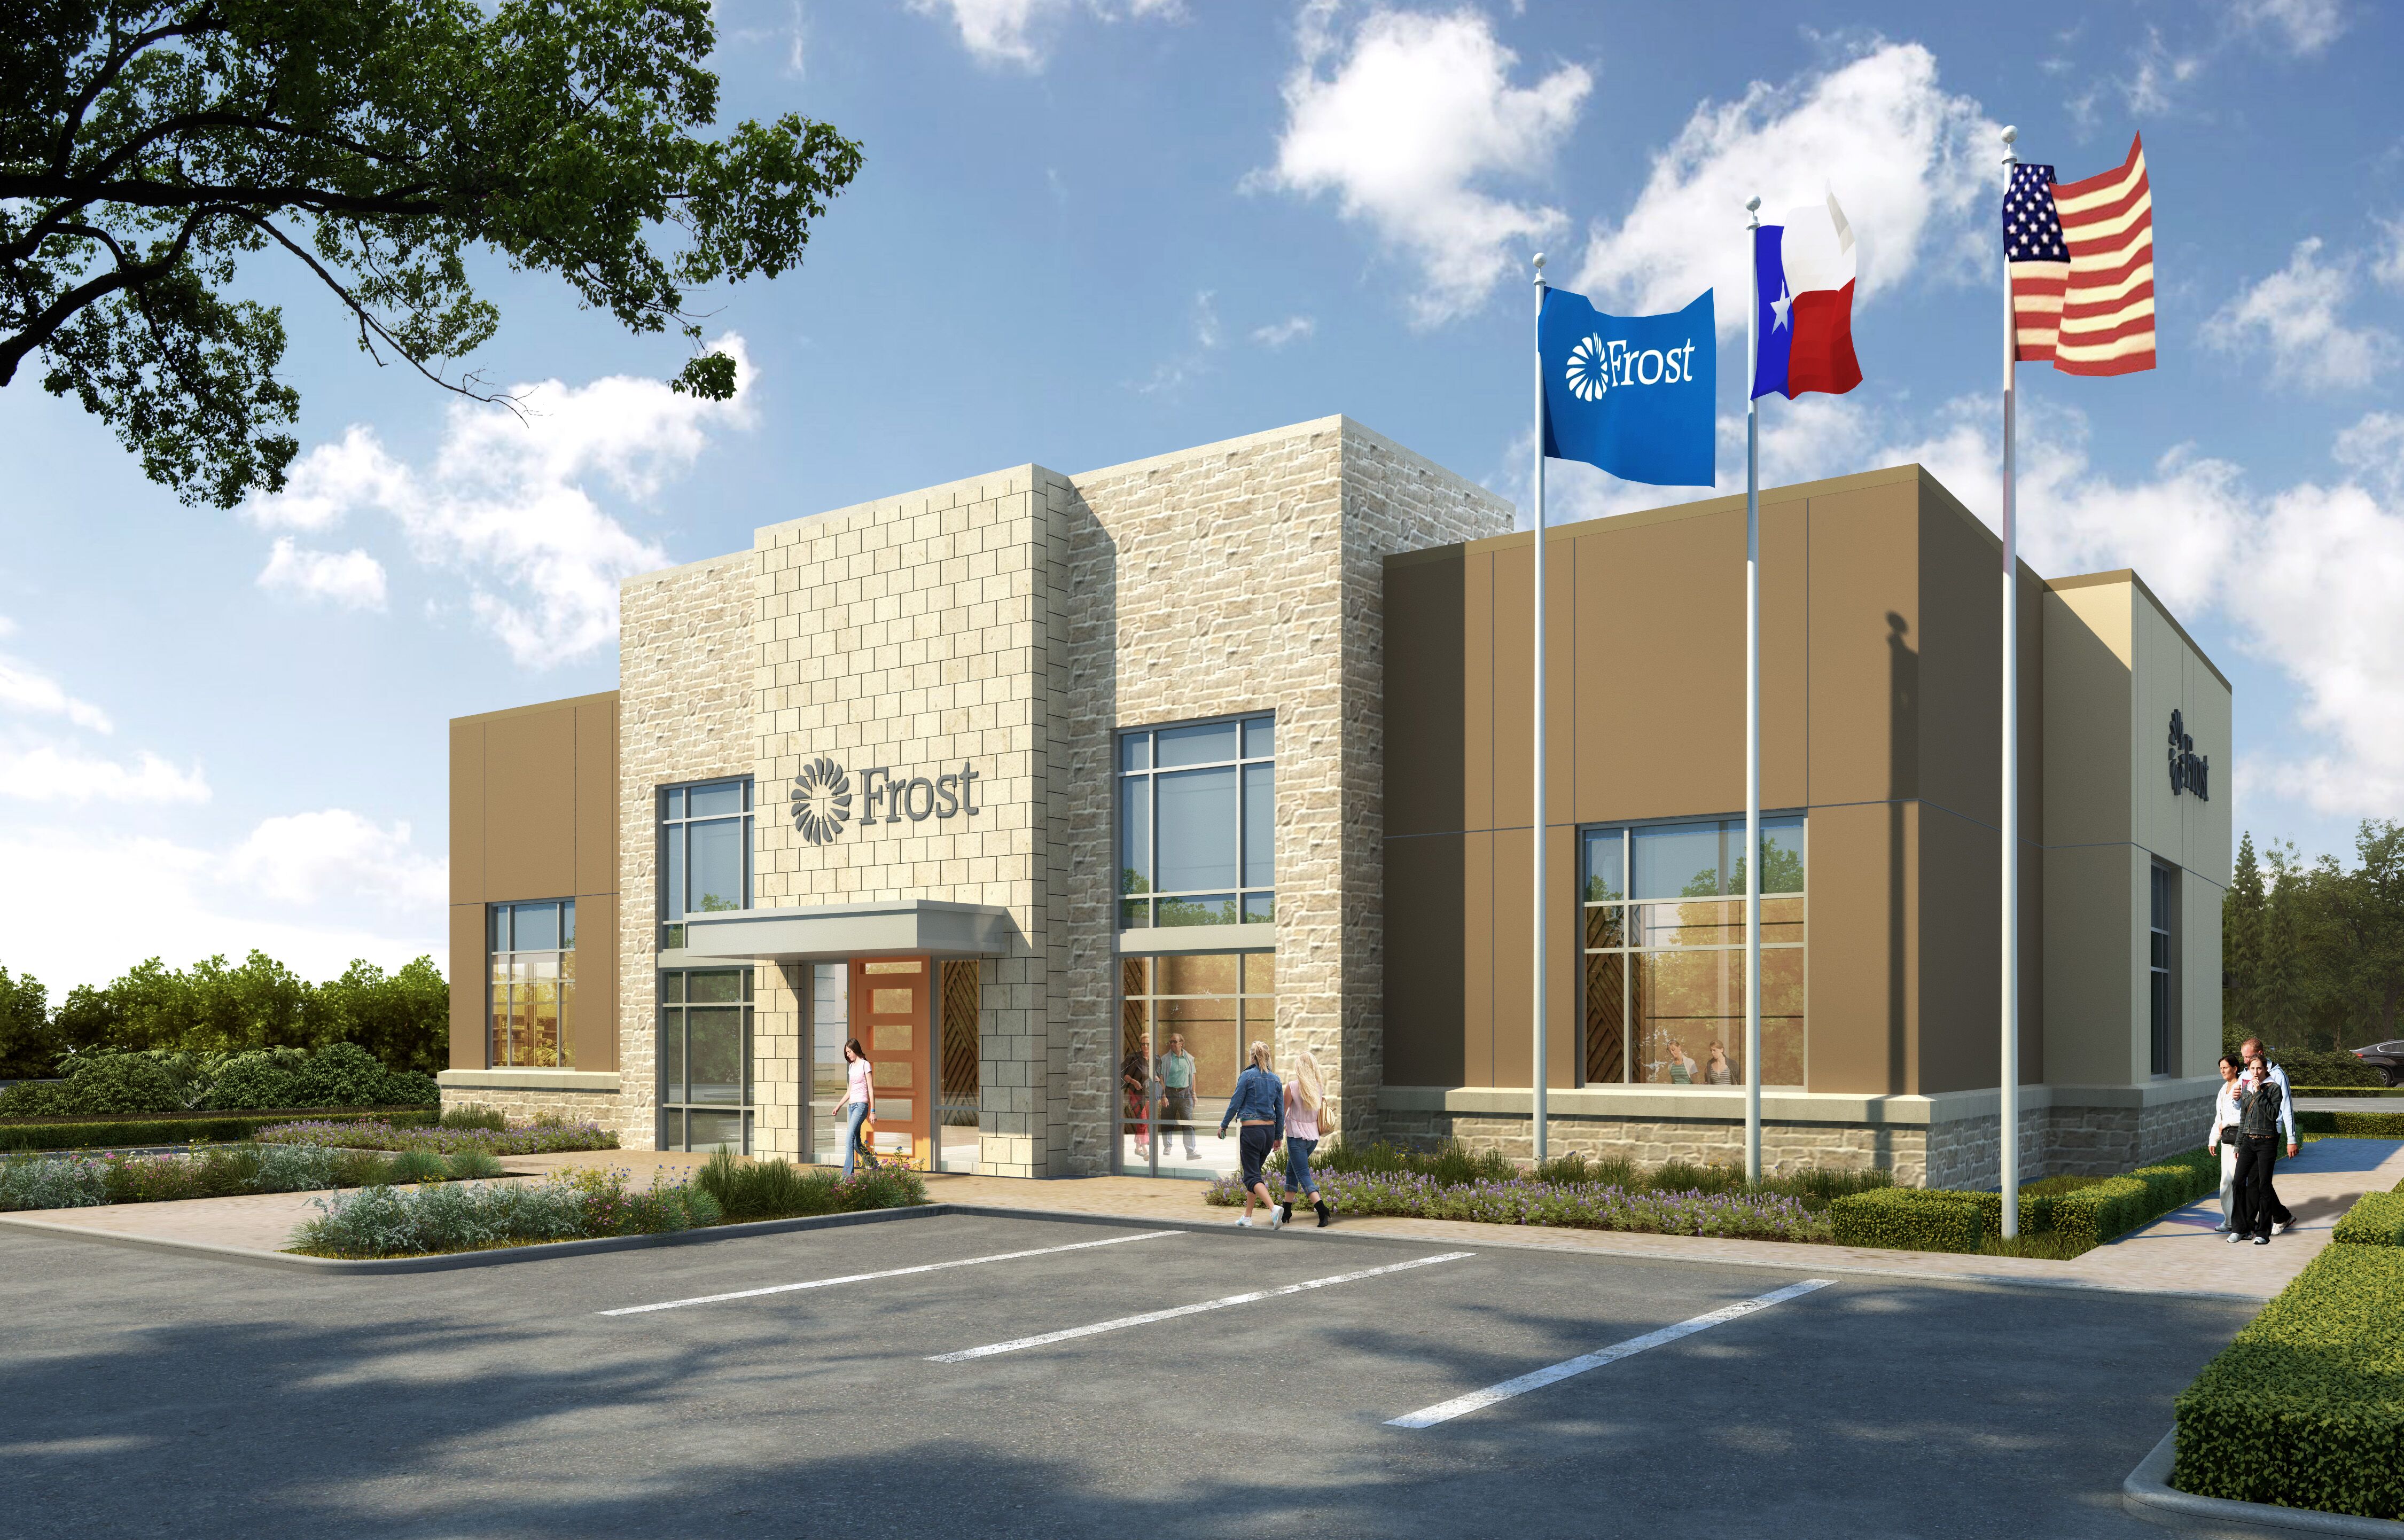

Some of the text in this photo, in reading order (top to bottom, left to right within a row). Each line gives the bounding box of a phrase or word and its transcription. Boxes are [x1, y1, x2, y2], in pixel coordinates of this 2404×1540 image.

[1607, 338, 1695, 387] Frost
[859, 762, 979, 825] Frost
[2183, 733, 2210, 802] Frost
